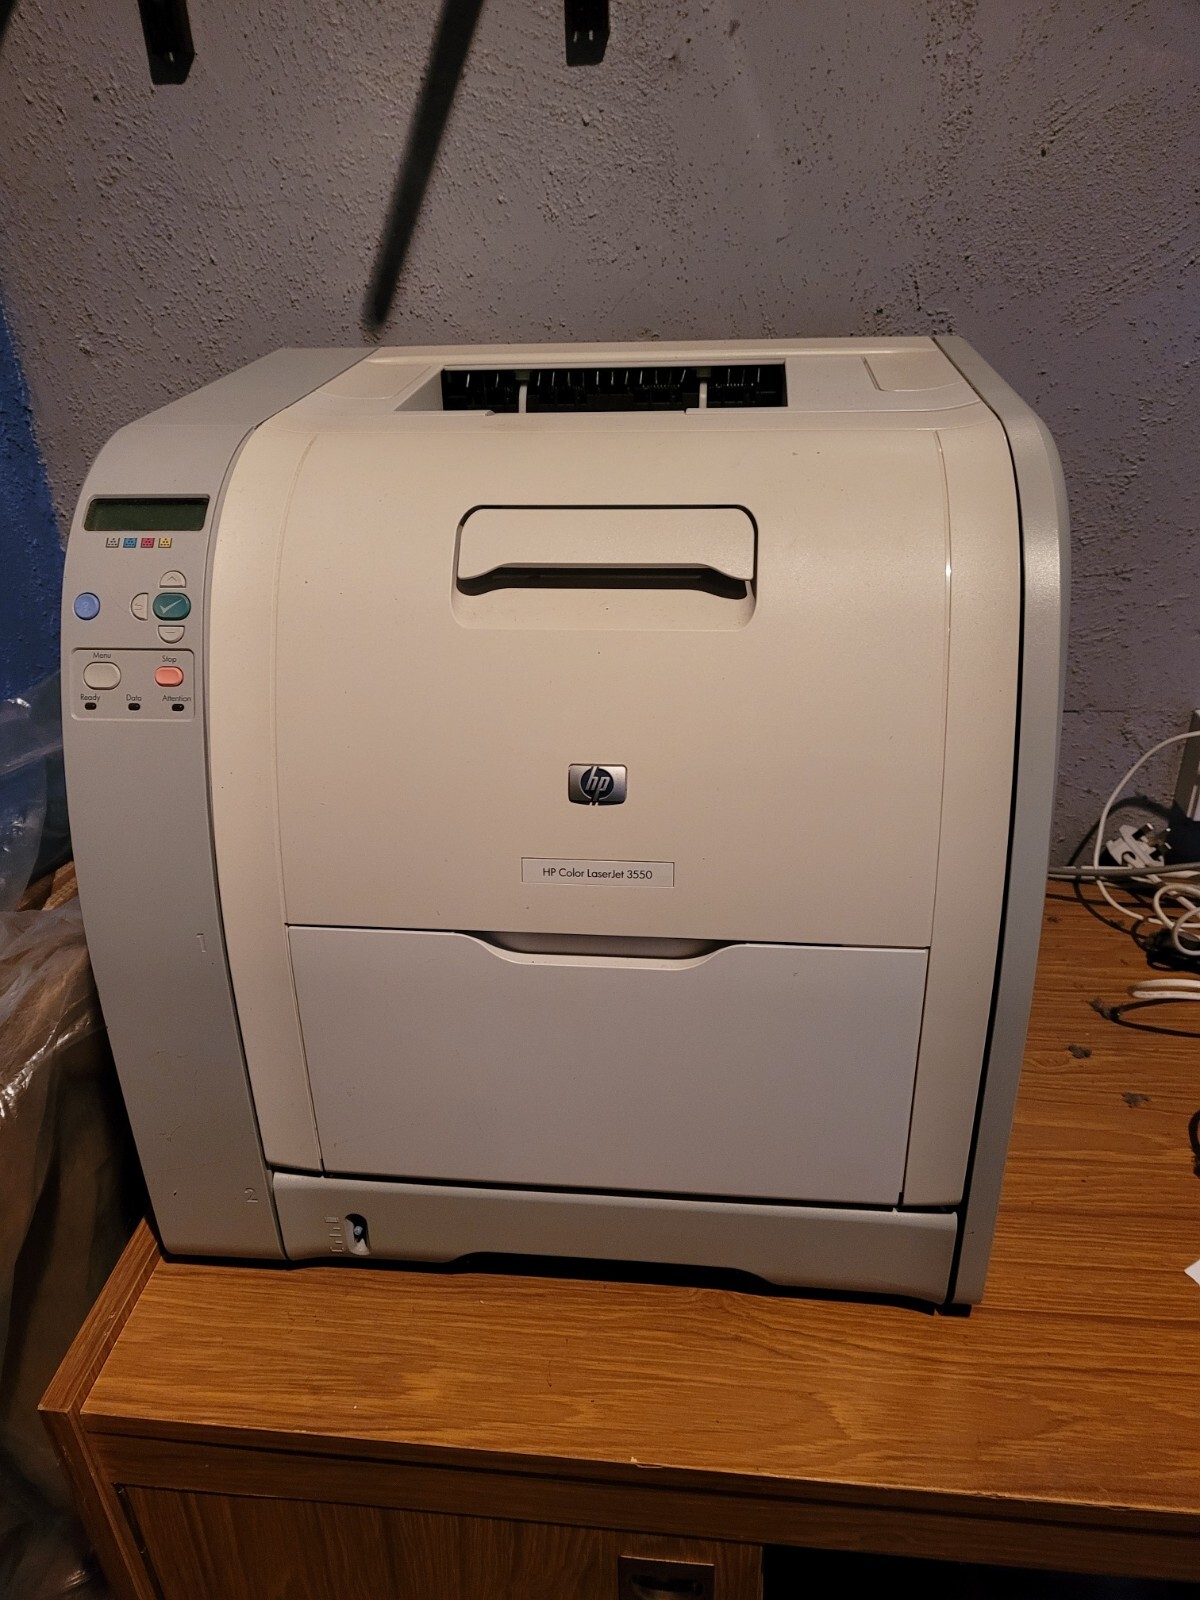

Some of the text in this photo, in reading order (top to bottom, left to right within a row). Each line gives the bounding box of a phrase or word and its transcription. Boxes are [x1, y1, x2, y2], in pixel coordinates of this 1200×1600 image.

[162, 655, 177, 664] Stop
[80, 693, 100, 702] Ready
[126, 694, 142, 702] Data
[162, 694, 192, 702] Attention
[583, 766, 612, 805] hp
[542, 867, 653, 880] HP Color LaserJet 3550
[196, 932, 206, 953] 1
[244, 1187, 258, 1203] 2
